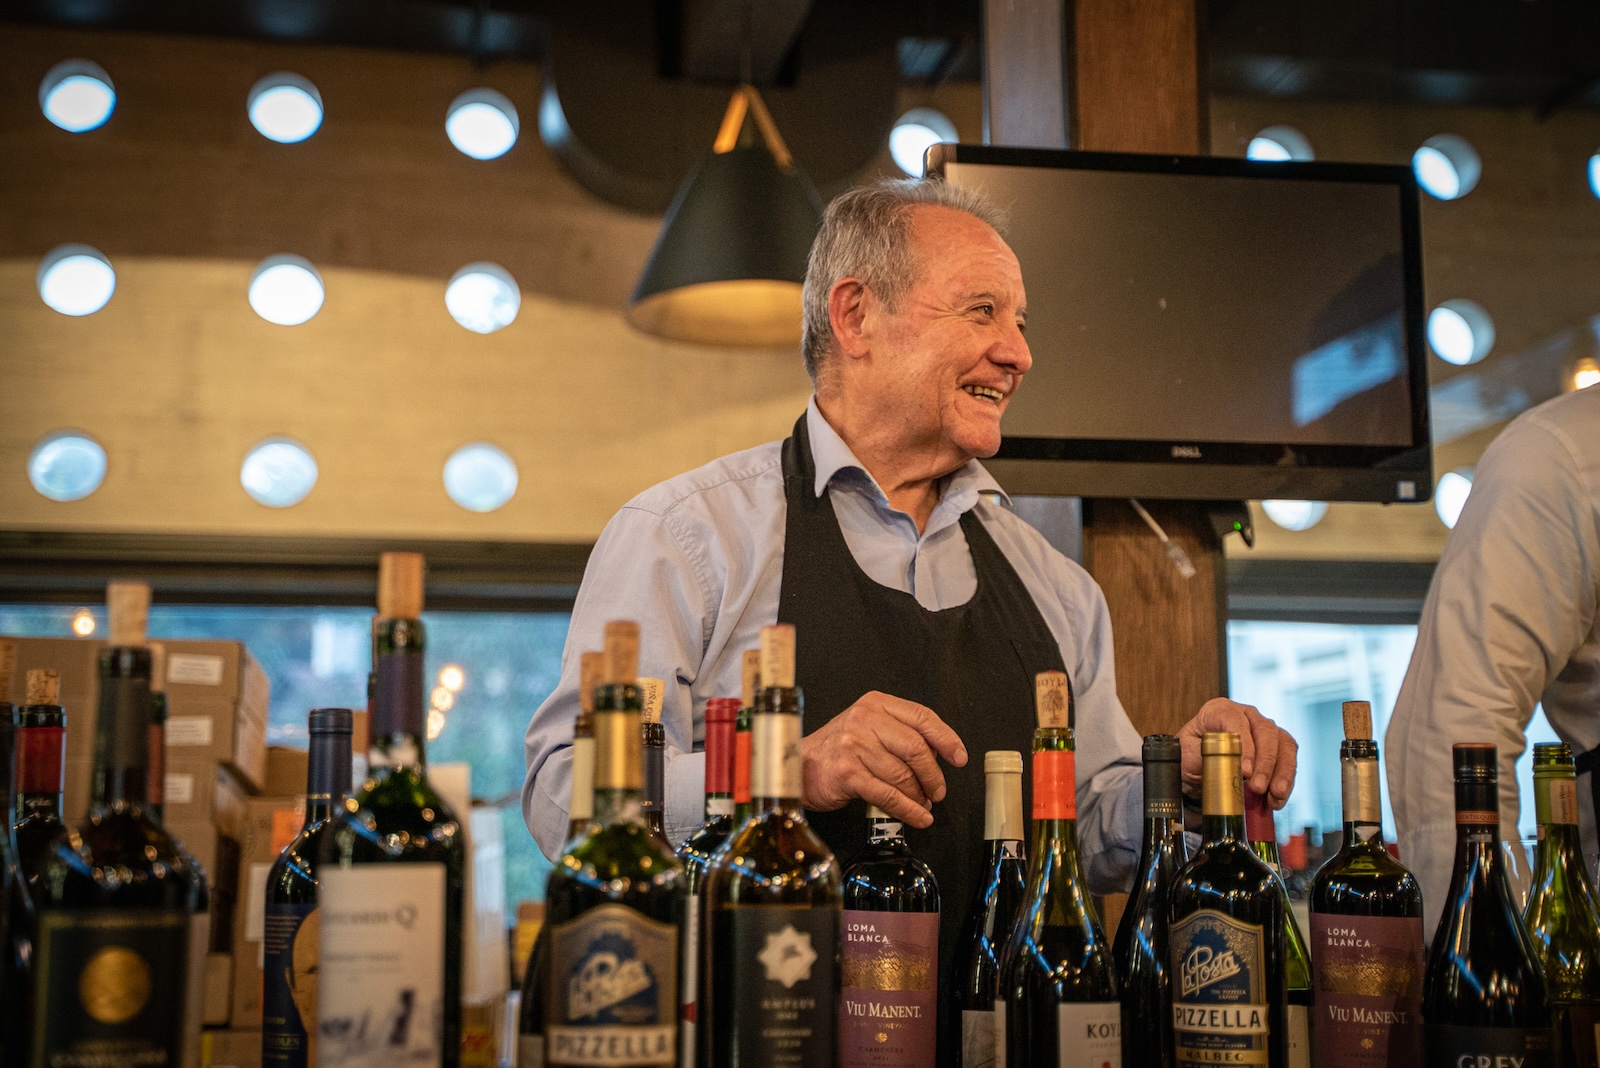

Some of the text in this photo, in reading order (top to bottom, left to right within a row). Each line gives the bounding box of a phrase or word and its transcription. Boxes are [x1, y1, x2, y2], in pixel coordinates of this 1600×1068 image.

[847, 923, 876, 933] LOMA
[1327, 927, 1357, 937] LOMA
[847, 933, 890, 944] BLANCA
[1327, 937, 1371, 948] BLANCA
[846, 1000, 921, 1019] VIU MANENT
[1328, 1005, 1407, 1025] VIU MANENT
[1175, 1007, 1262, 1029] PIZZELLA
[1185, 1050, 1244, 1063] MALBEC
